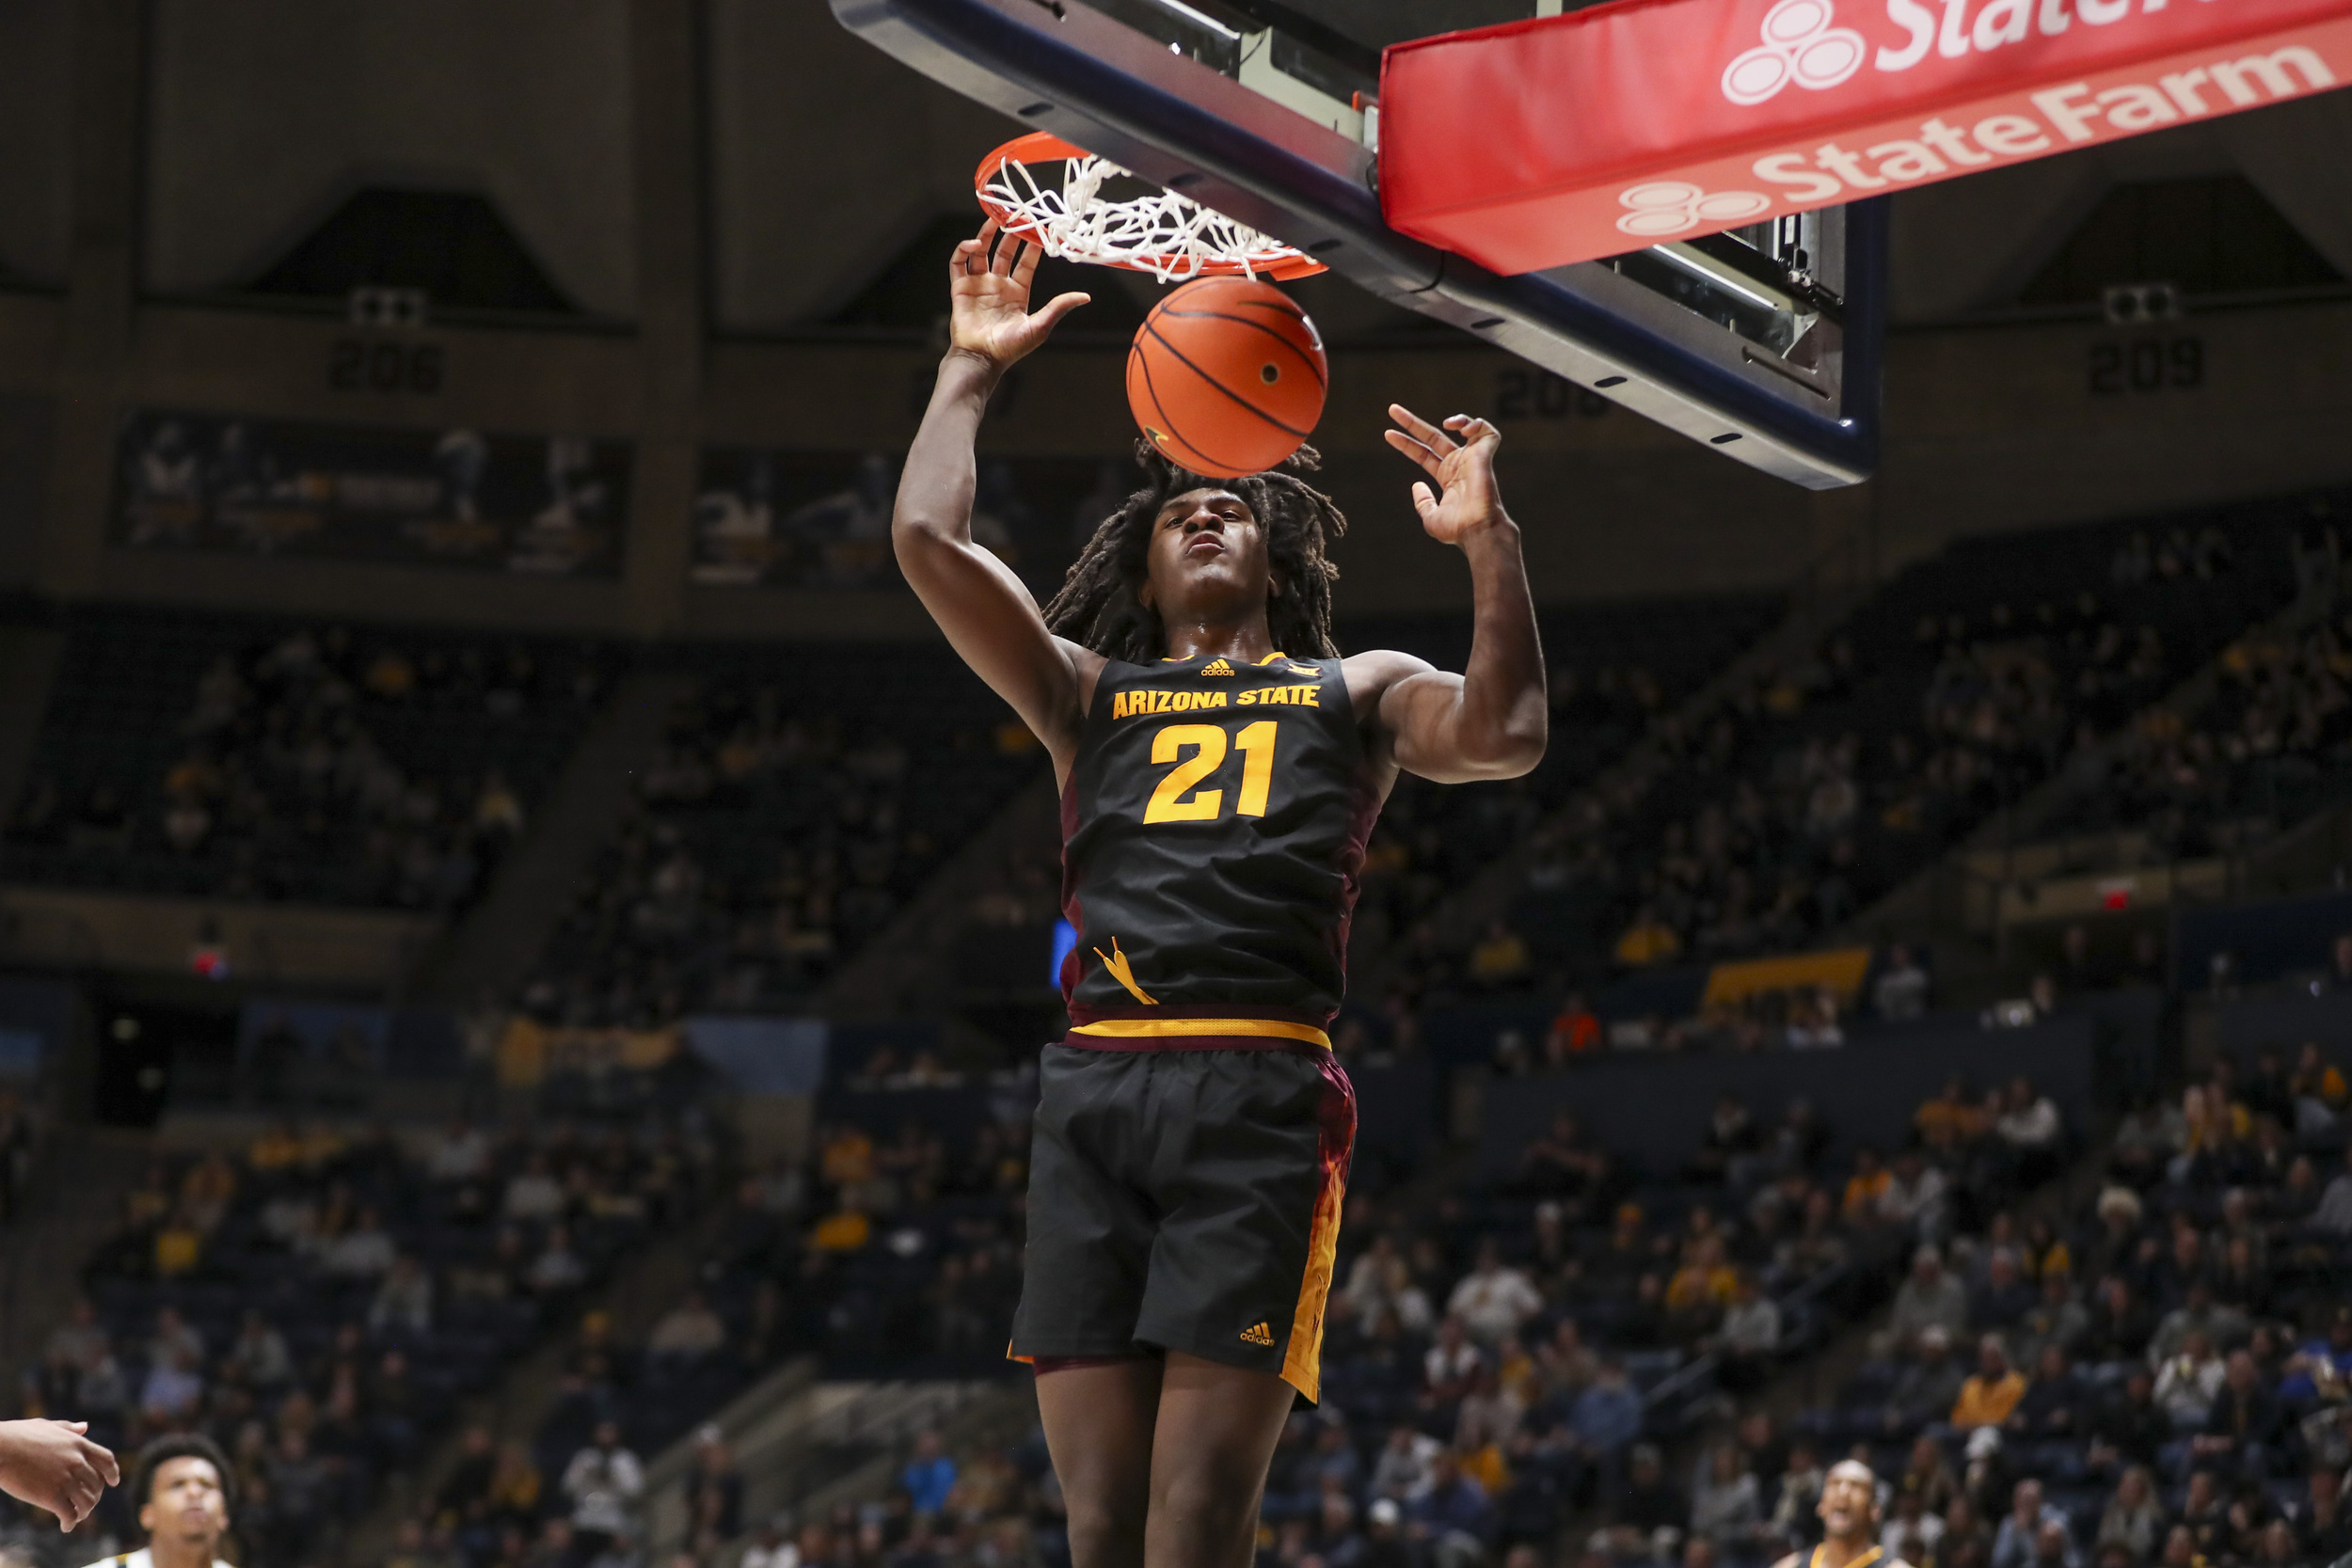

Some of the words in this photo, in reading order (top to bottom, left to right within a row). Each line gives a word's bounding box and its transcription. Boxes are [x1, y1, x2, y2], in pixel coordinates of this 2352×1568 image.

[330, 341, 441, 393] 206
[2090, 337, 2202, 392] 209
[1200, 668, 1235, 676] adidas
[1113, 690, 1228, 720] ARIZONA
[1236, 685, 1322, 707] STATE
[1143, 721, 1278, 825] 21
[1240, 1332, 1275, 1346] adidas
